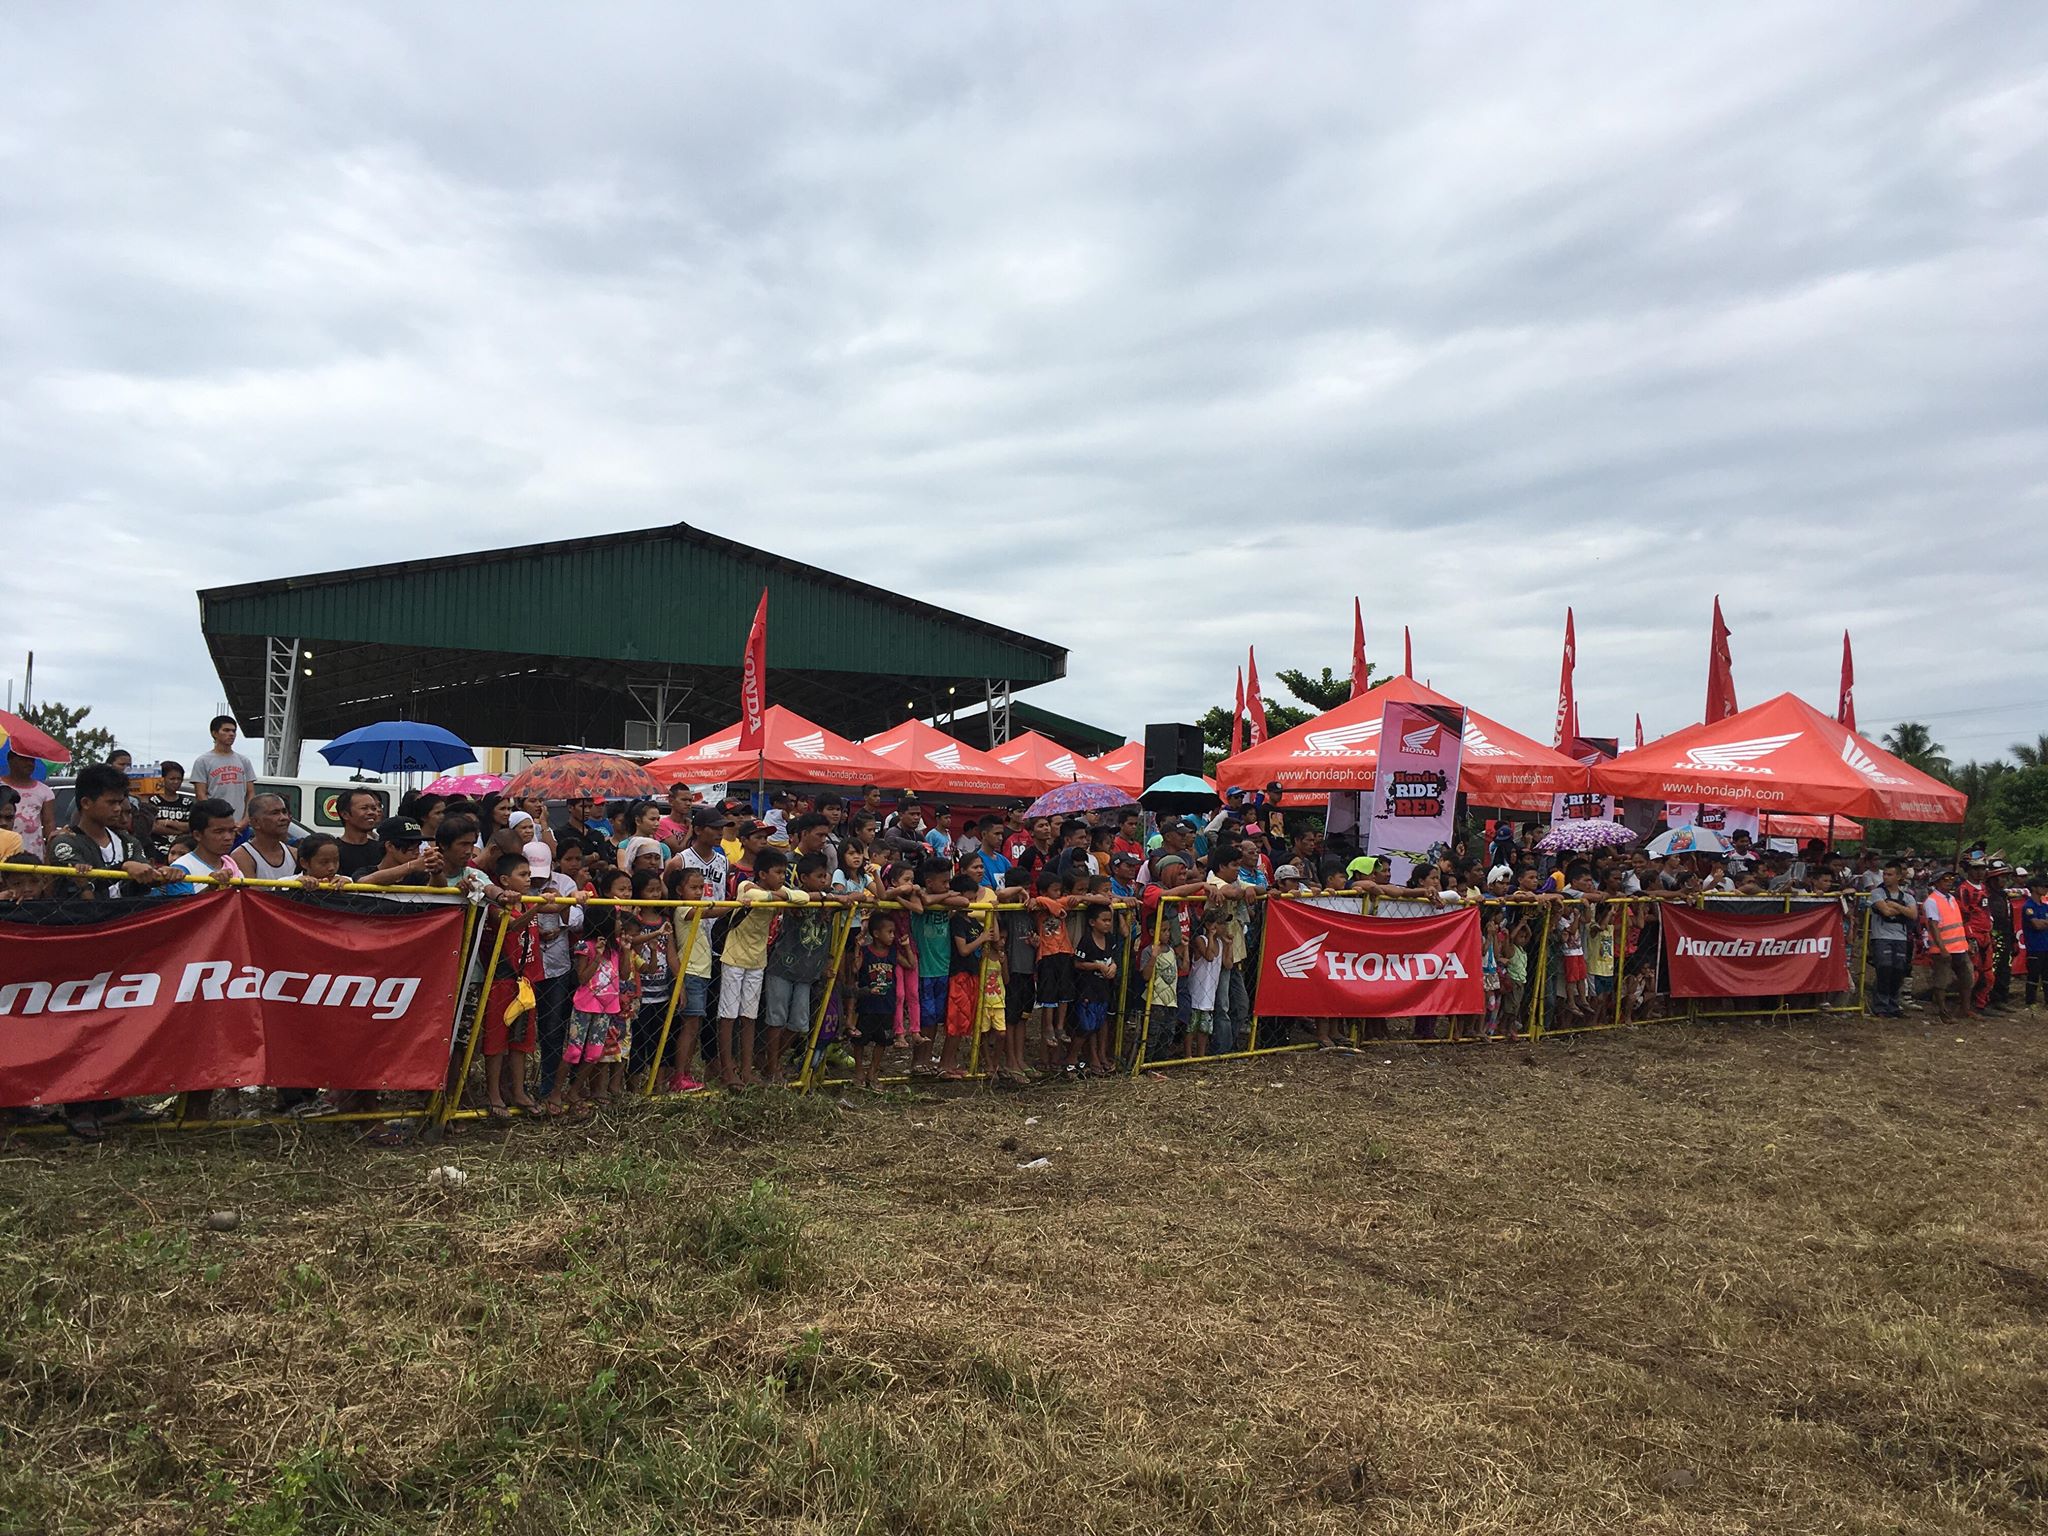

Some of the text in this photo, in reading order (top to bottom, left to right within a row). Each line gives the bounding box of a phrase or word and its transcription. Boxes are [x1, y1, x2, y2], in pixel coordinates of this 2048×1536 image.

[793, 753, 852, 761] HONDA
[1290, 749, 1378, 757] HONDA
[1402, 746, 1437, 756] HONDA
[1467, 747, 1525, 758] HONA
[1672, 762, 1775, 775] HONDA
[808, 769, 874, 781] www.hondaph.com
[1395, 771, 1438, 782] Honda
[1396, 784, 1438, 797] RIDE
[1662, 783, 1784, 800] www.hondaph.com
[1569, 794, 1600, 805] RIE
[1396, 799, 1439, 815] RED
[1676, 936, 1833, 958] Honda Racing
[1324, 951, 1469, 983] HONDA
[174, 960, 422, 1020] Racing
